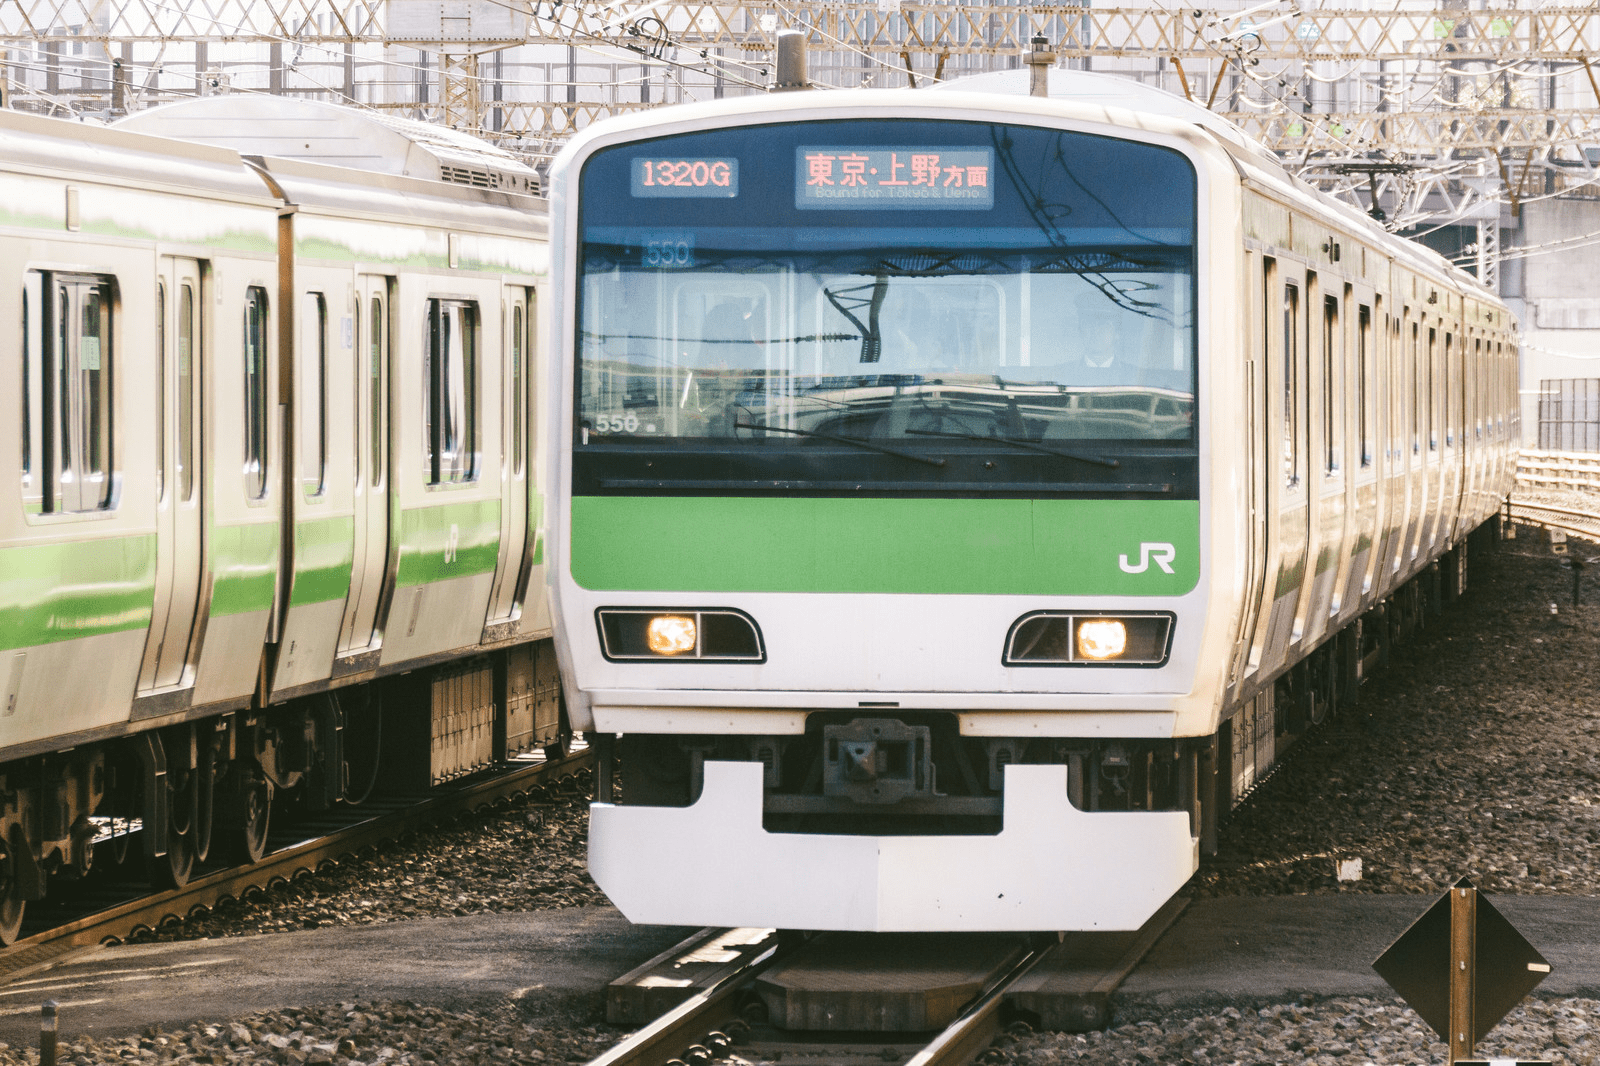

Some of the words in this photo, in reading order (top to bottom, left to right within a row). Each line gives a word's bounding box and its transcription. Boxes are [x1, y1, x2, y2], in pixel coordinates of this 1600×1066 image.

[643, 160, 731, 187] 1320G
[815, 186, 859, 198] Bound
[861, 186, 882, 198] for
[944, 186, 980, 198] Ueno
[647, 241, 690, 264] 550
[1119, 542, 1175, 574] JR
